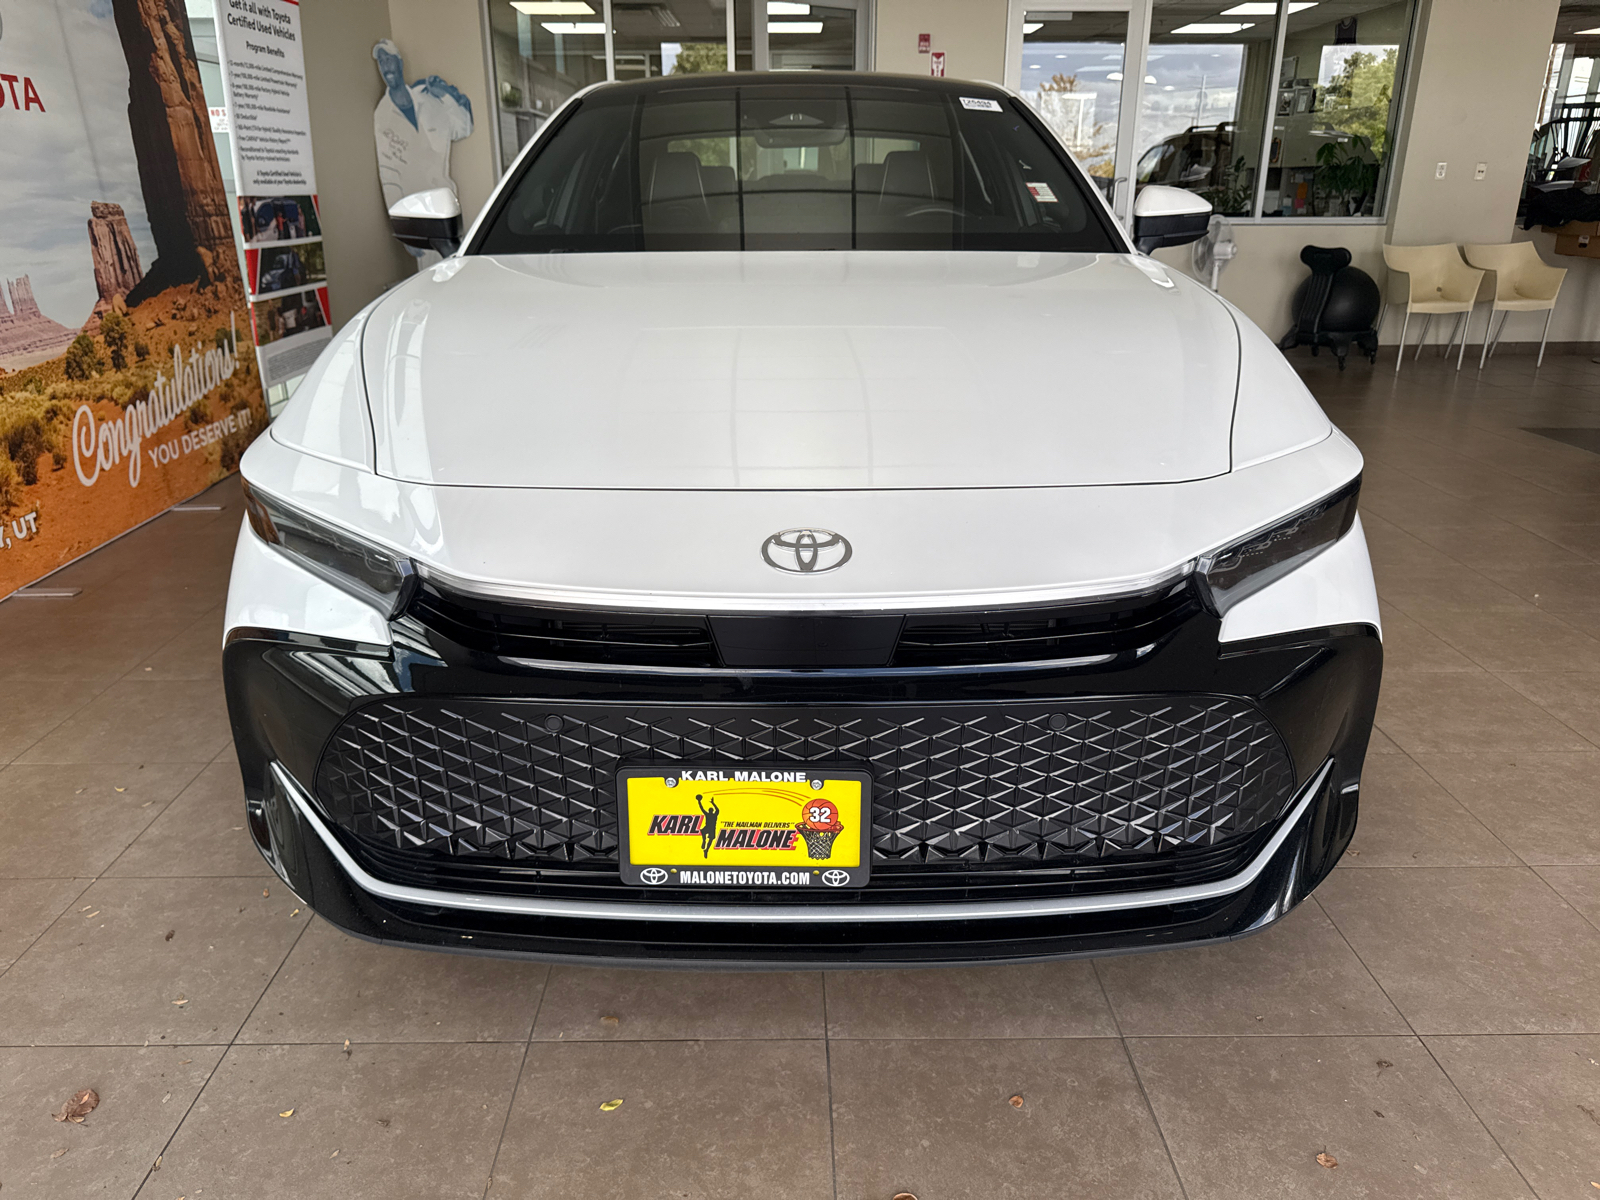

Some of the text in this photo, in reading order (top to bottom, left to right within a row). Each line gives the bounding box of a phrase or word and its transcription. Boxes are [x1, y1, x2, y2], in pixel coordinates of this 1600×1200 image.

[228, 0, 292, 24] Get it all with Toyota
[227, 13, 296, 41] Certified Used Vehicles
[246, 40, 285, 58] Program Benefits
[72, 310, 240, 488] Congratulations!
[148, 408, 253, 469] YOU DESERVE IT!
[11, 511, 37, 539] UT
[681, 771, 807, 783] KARL MALONE
[647, 814, 704, 836] KARL
[809, 807, 831, 823] 32
[714, 829, 800, 851] MALONE
[680, 870, 810, 885] MALONETOYOTA.COM
